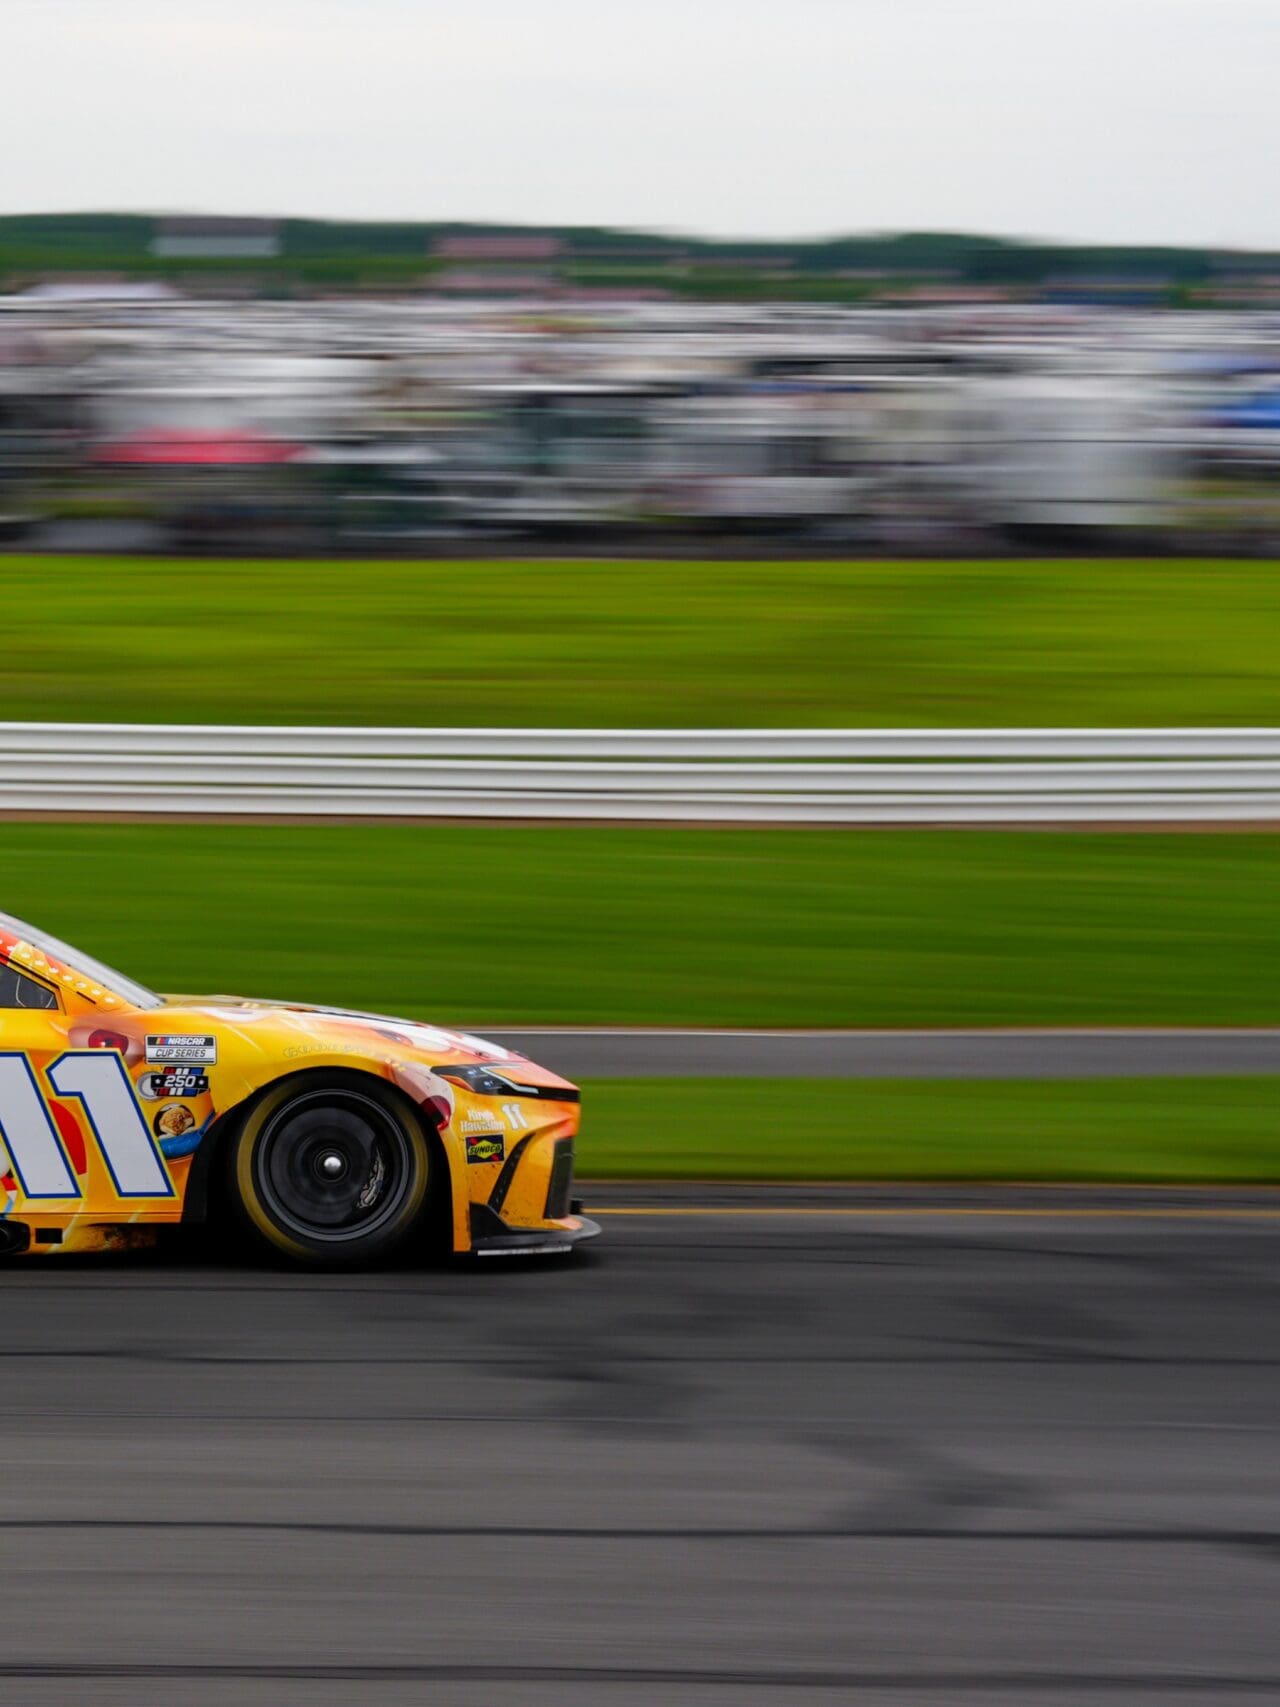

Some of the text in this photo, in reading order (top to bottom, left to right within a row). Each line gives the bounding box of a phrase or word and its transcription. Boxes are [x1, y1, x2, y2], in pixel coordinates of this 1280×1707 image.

[167, 1037, 206, 1046] NASCAR
[155, 1048, 206, 1058] CUP SERIES
[164, 1075, 196, 1088] 250
[469, 1144, 501, 1154] SUNOCO
